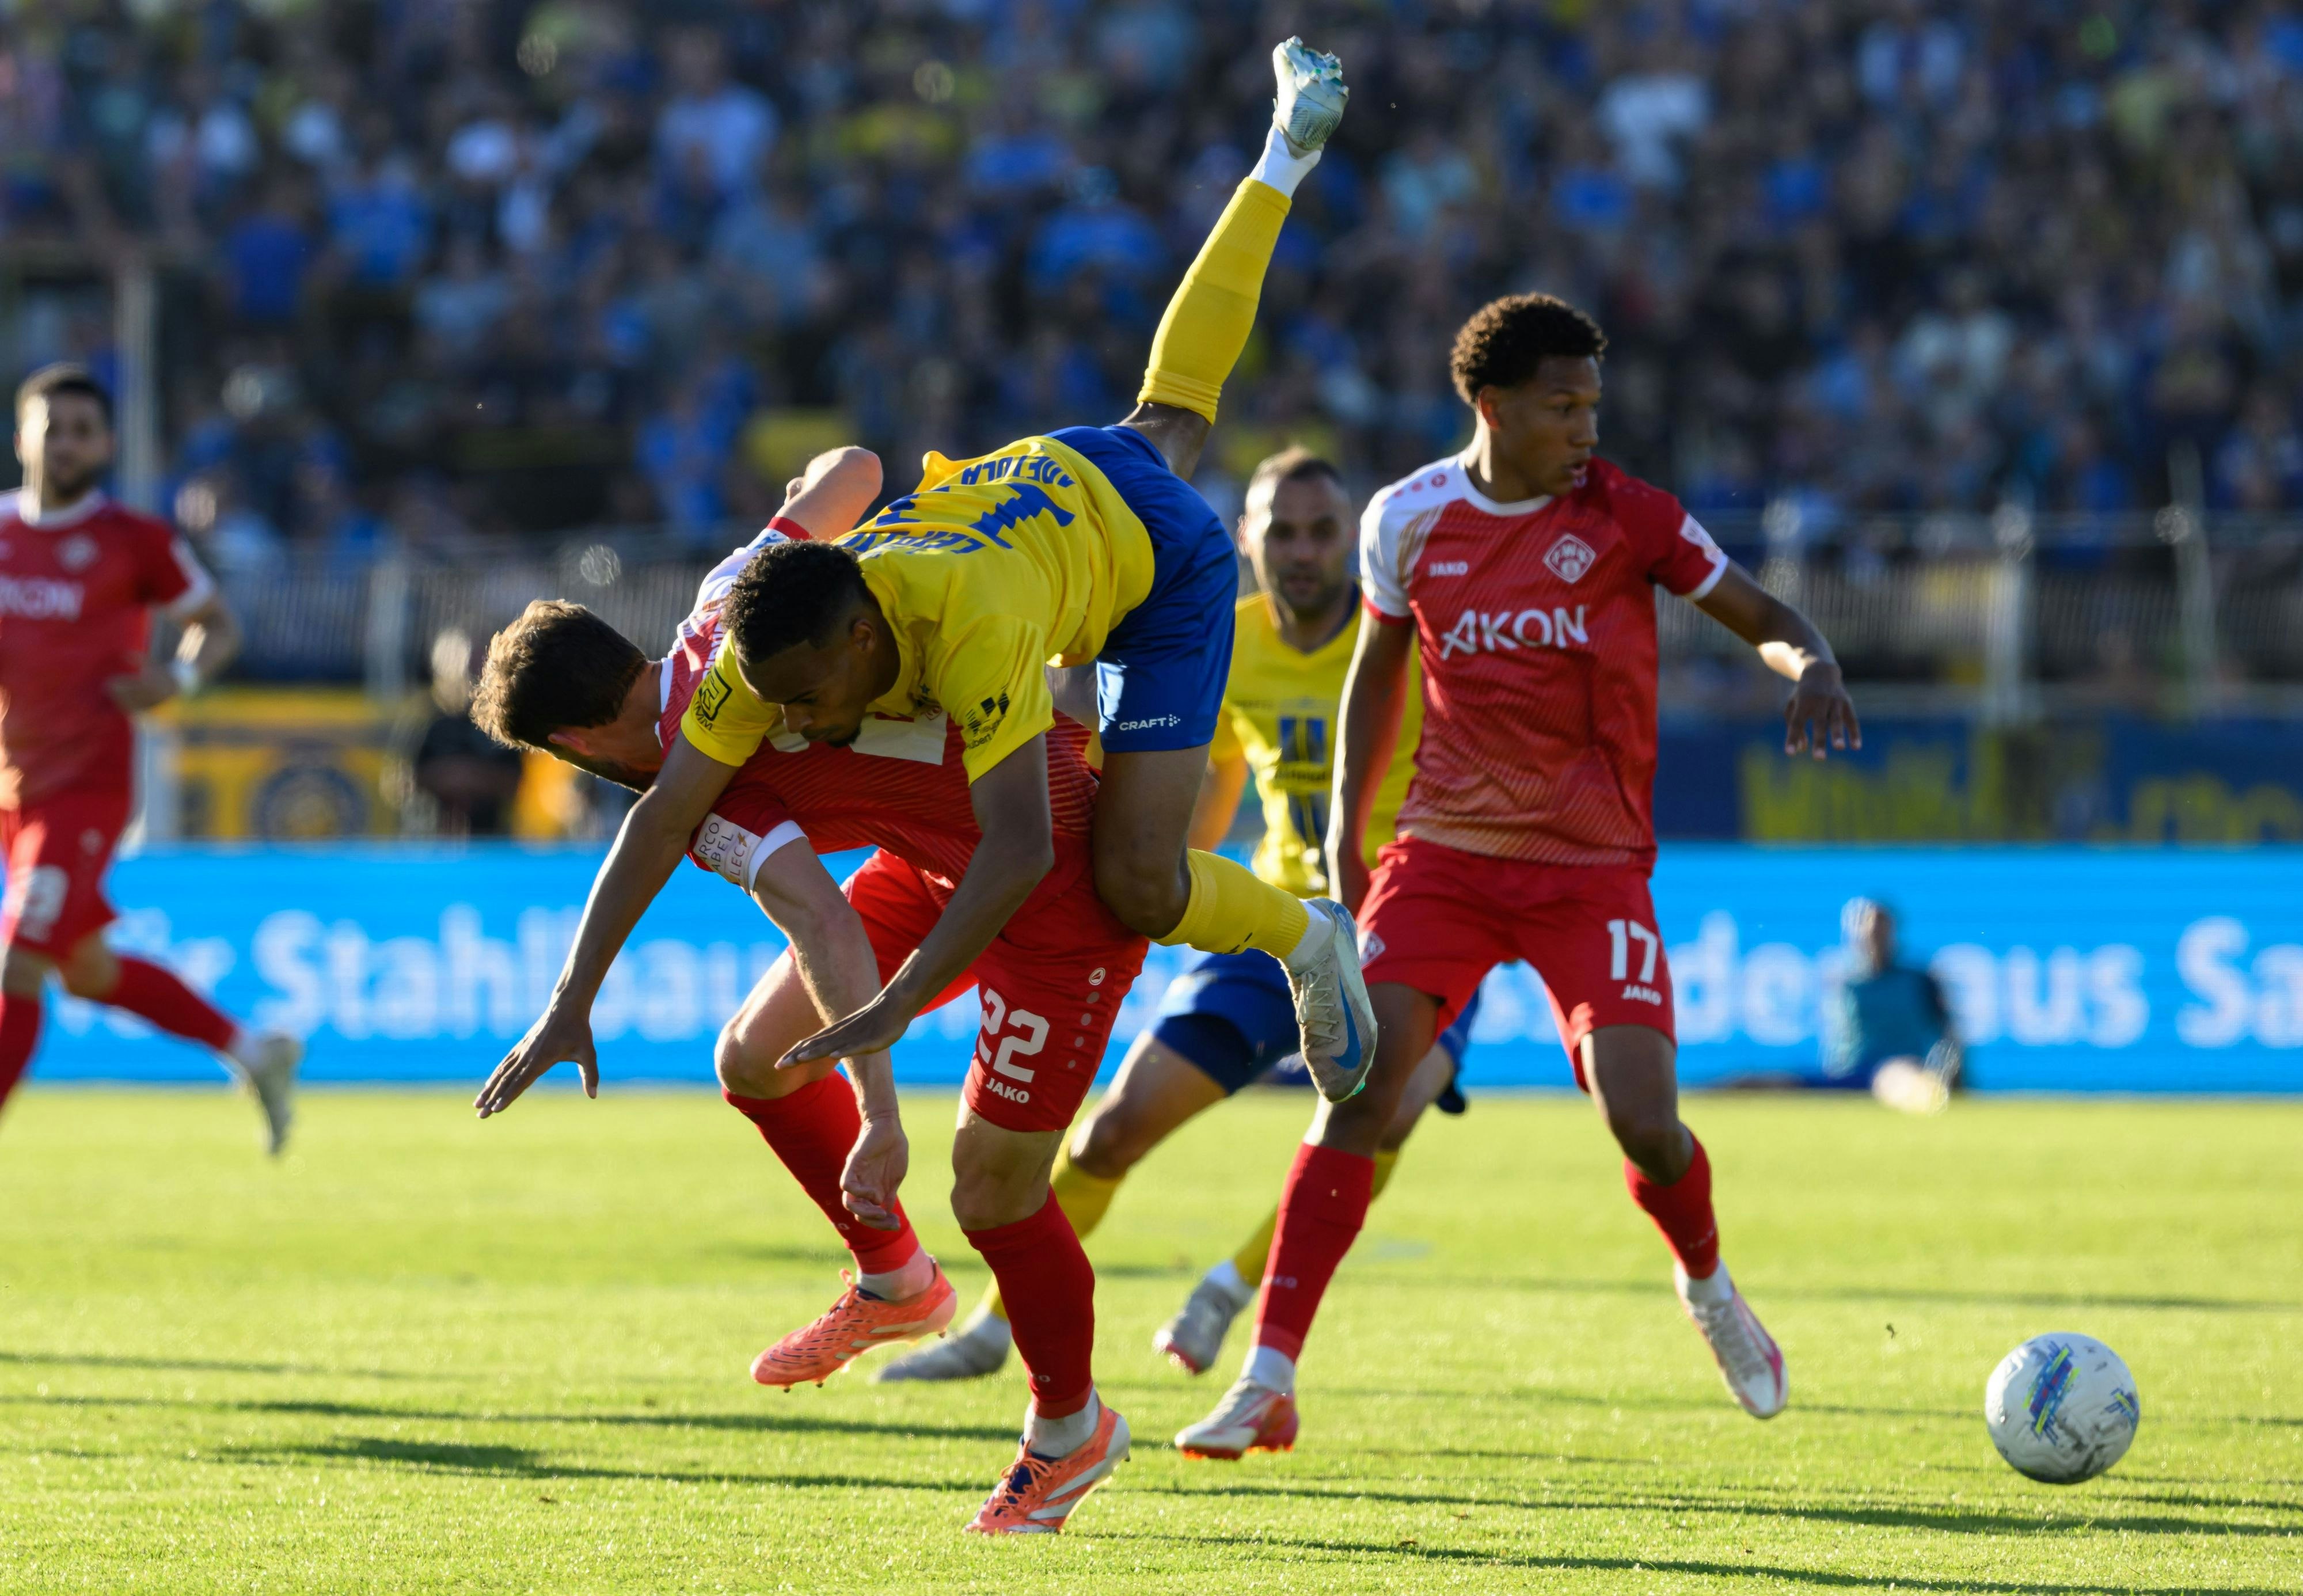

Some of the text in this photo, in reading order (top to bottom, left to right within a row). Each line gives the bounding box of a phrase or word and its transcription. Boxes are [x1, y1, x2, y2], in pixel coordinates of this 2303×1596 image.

[1441, 605, 1589, 660] AKON
[1119, 717, 1167, 731] CRAFT
[1607, 919, 1658, 985] 17
[1621, 984, 1663, 1006] JAKO
[979, 988, 1050, 1083] 22
[986, 1078, 1030, 1104] JAKO
